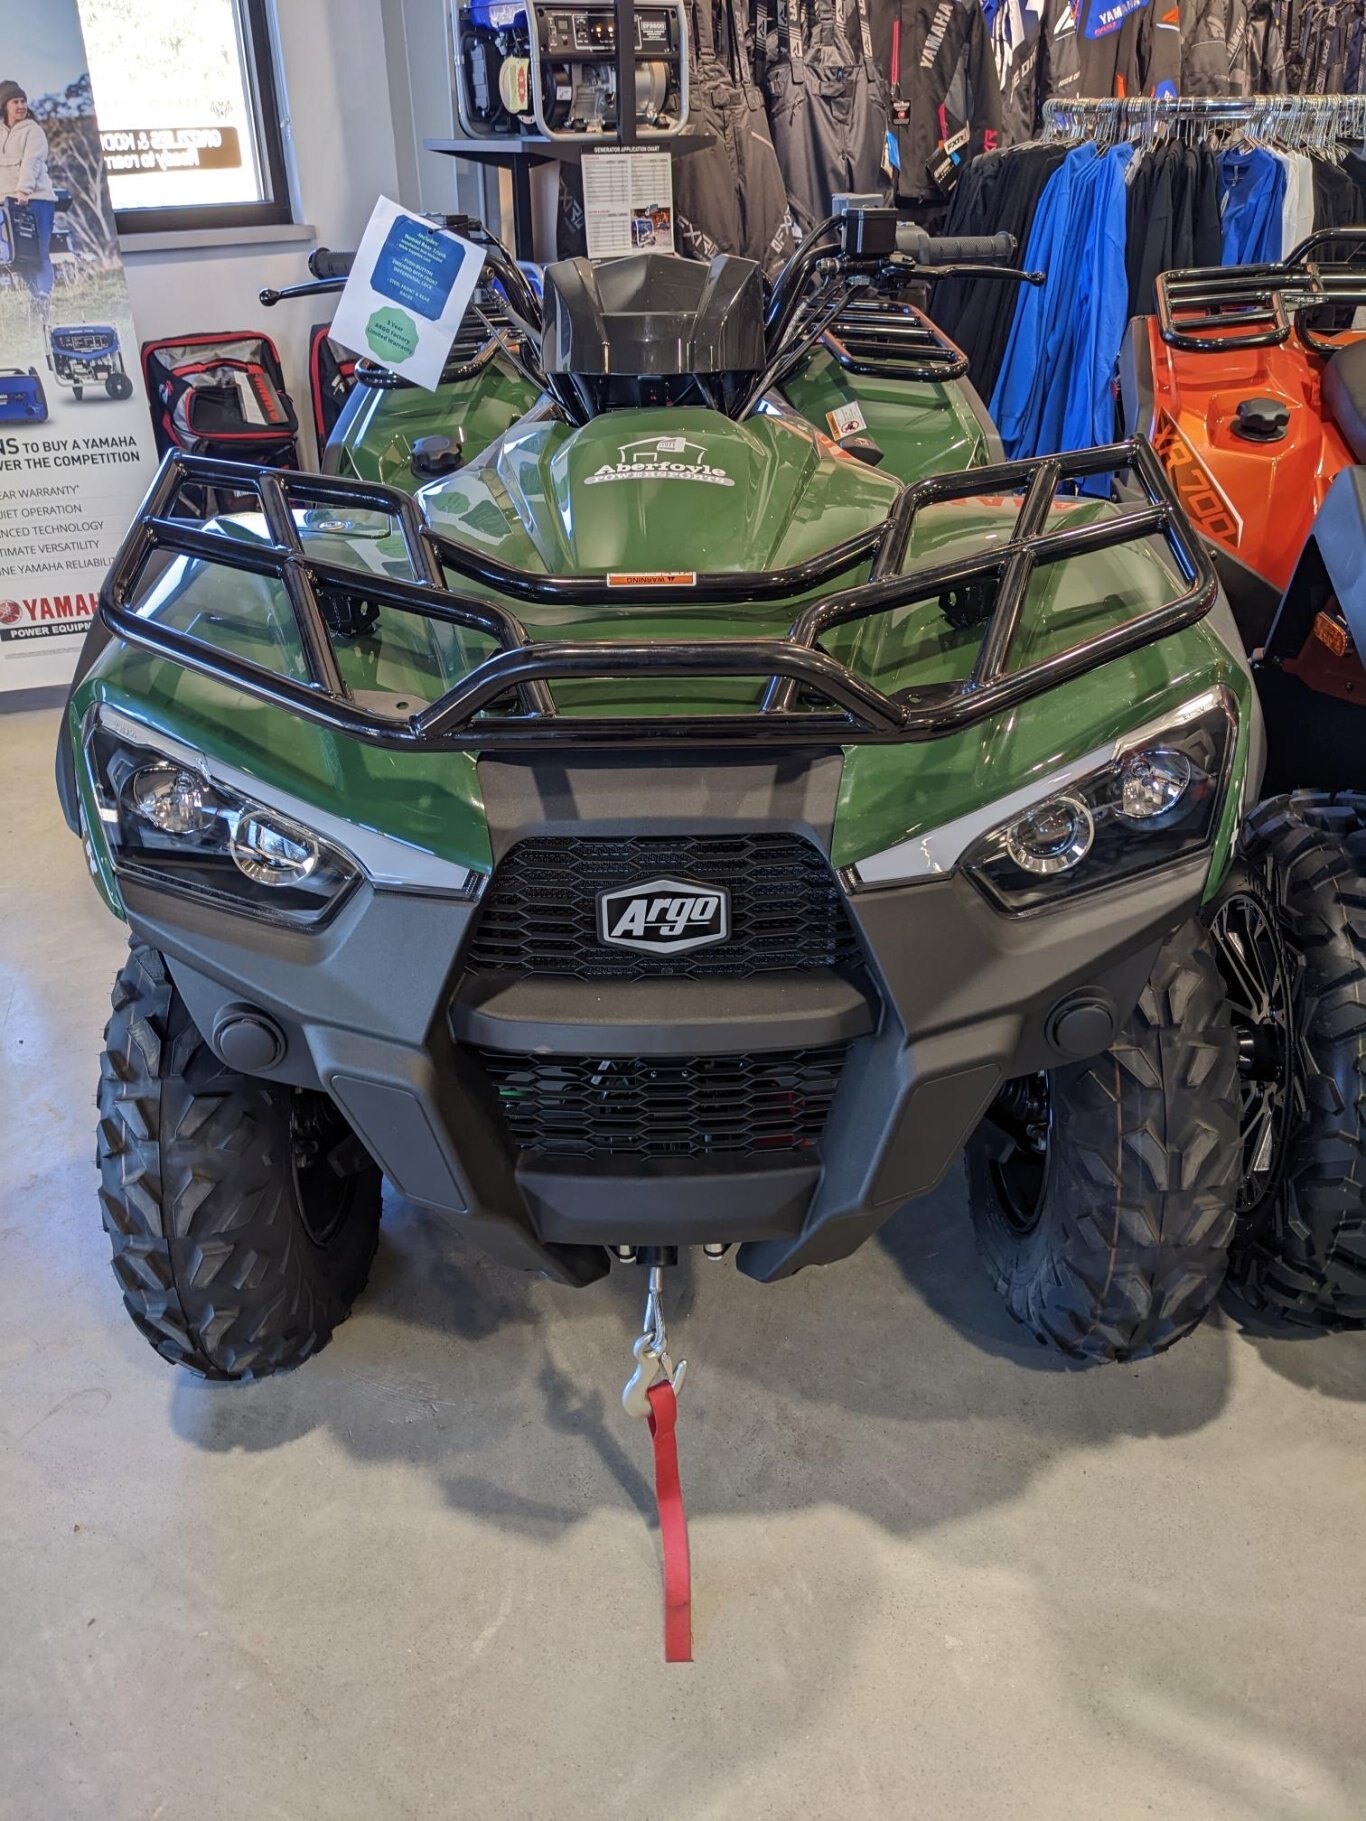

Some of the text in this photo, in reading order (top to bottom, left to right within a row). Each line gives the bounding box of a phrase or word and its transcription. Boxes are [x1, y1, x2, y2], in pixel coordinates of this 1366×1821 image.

[920, 3, 953, 69] YAMAHA
[366, 327, 413, 354] Limited Warranty
[374, 322, 410, 344] ARGO Factory
[22, 442, 39, 454] TO
[43, 440, 68, 452] BUY
[72, 440, 81, 450] A
[82, 436, 137, 450] YAMAHA
[24, 457, 51, 470] THE
[54, 451, 140, 467] COMPETITION
[594, 462, 726, 477] Aberfoyle
[594, 471, 726, 484] POWERSPORTS
[21, 504, 82, 517] OPERATION
[1181, 468, 1236, 537] 700
[32, 521, 104, 535] TECHNOLOGY
[38, 540, 99, 554] VERSATILITY
[17, 562, 63, 574] YAMAHA
[10, 627, 49, 638] POWER
[610, 897, 719, 936] Argo
